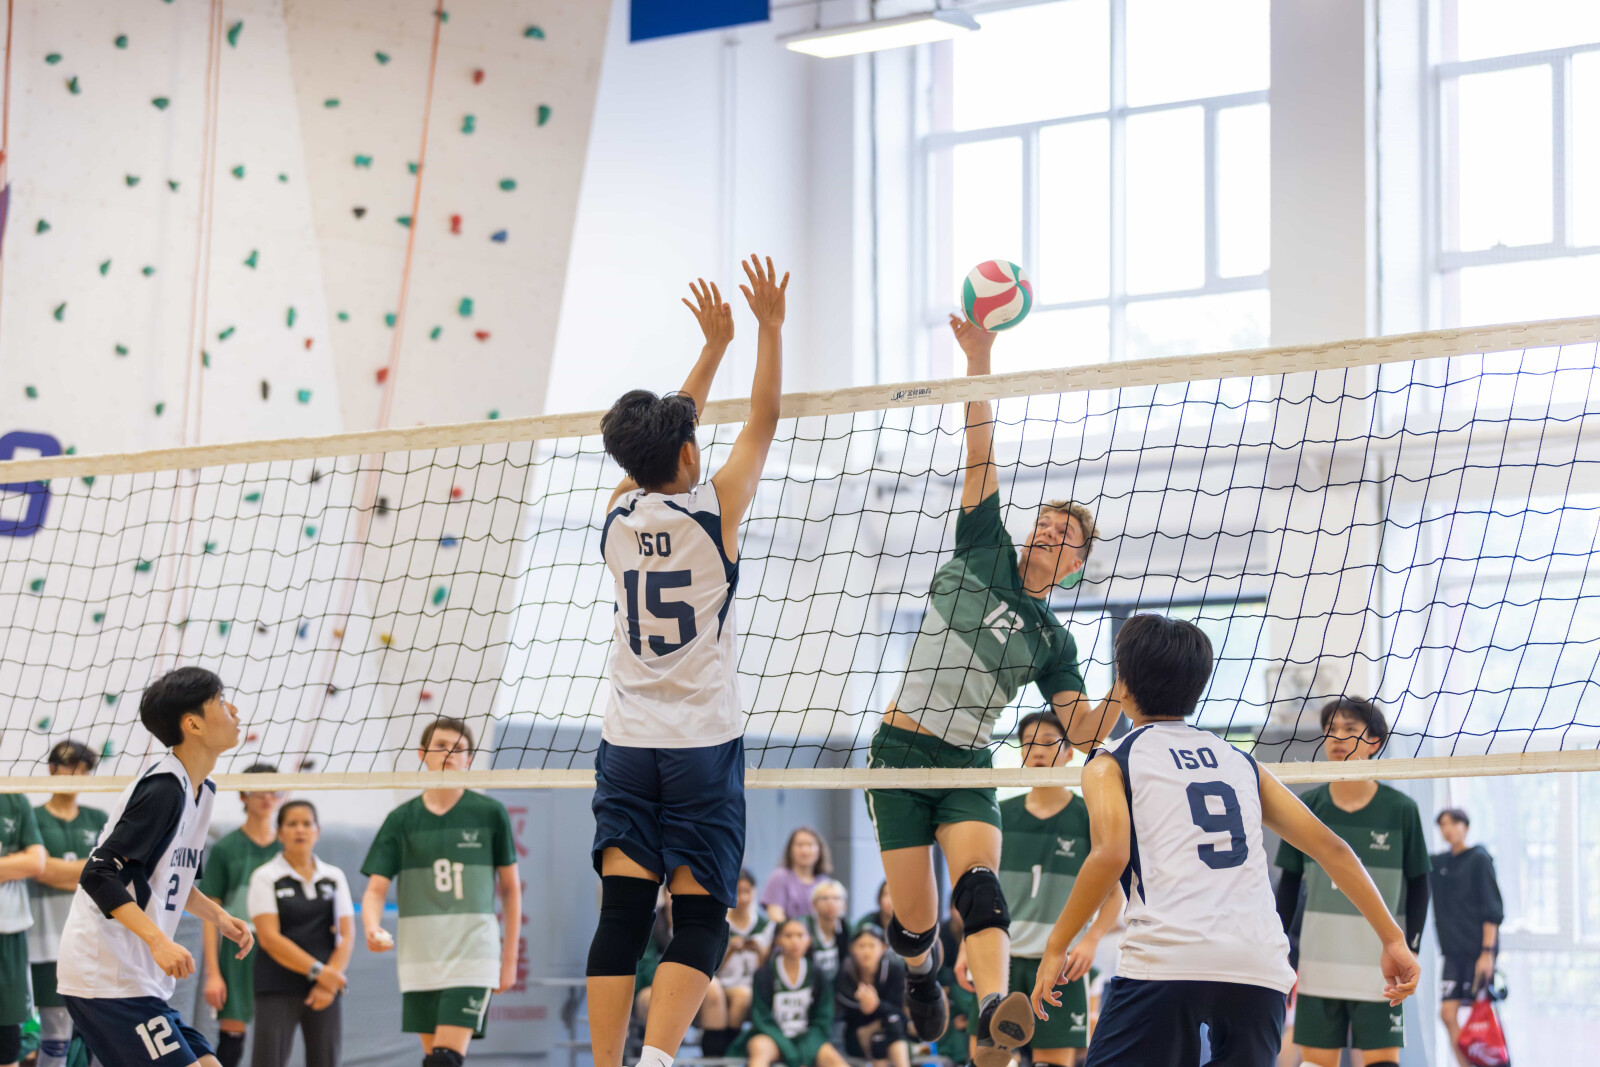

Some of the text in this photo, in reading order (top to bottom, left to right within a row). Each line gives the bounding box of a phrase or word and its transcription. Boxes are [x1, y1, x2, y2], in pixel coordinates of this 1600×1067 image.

[624, 569, 698, 657] 15
[1185, 780, 1249, 870] 9
[1031, 864, 1042, 899] 1
[135, 1015, 181, 1061] 12
